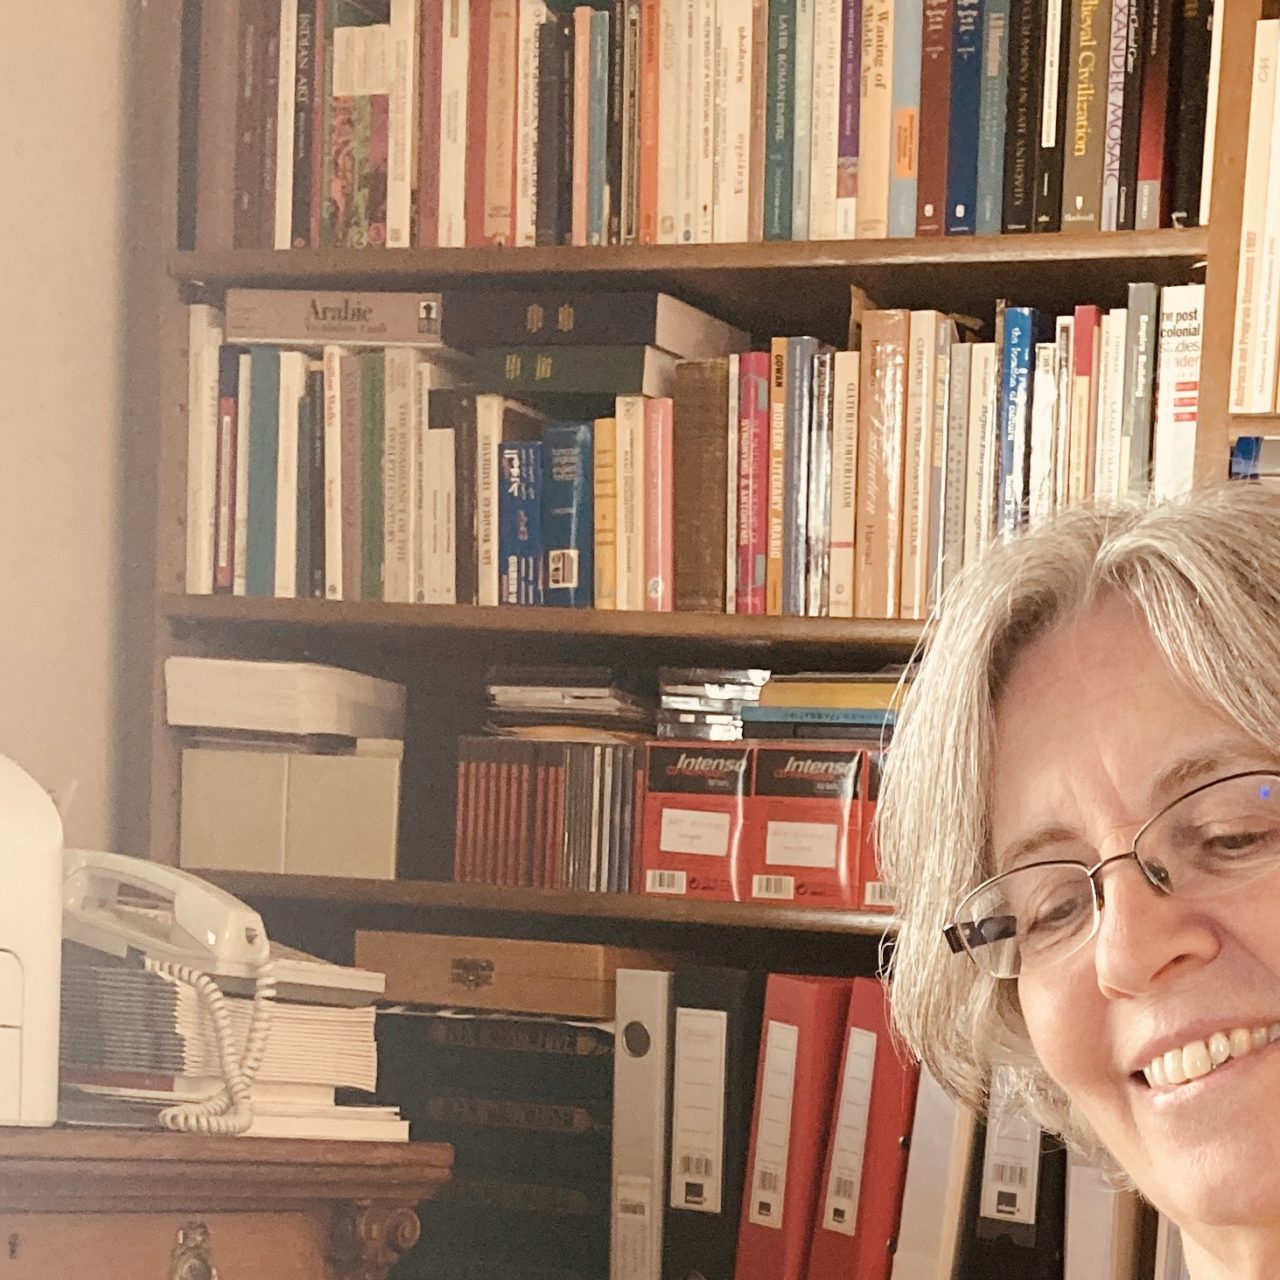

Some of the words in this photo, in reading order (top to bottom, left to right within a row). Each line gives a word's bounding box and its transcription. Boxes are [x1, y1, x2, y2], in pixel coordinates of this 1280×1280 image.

[298, 13, 312, 69] INDIAN
[874, 11, 889, 67] Waning
[1110, 0, 1127, 93] XANDER
[298, 74, 309, 105] ART
[875, 73, 886, 89] of
[1074, 52, 1095, 156] Civilization
[1105, 103, 1123, 188] MOSAIC
[311, 298, 373, 321] Arabic
[1161, 323, 1200, 338] colonial
[1176, 308, 1198, 324] post
[1010, 327, 1021, 344] the
[1138, 315, 1148, 352] Empire
[774, 354, 784, 388] COWAN
[1008, 347, 1021, 387] location
[1135, 354, 1147, 398] Building
[845, 382, 855, 426] CULTURE
[1006, 404, 1018, 441] culture
[740, 418, 750, 474] SYNONYMS
[772, 402, 783, 451] MODERN
[771, 457, 783, 511] LITERARY
[843, 444, 853, 508] IMPERIALISM
[740, 490, 749, 545] ANTONYMS
[770, 517, 781, 558] ARABIC
